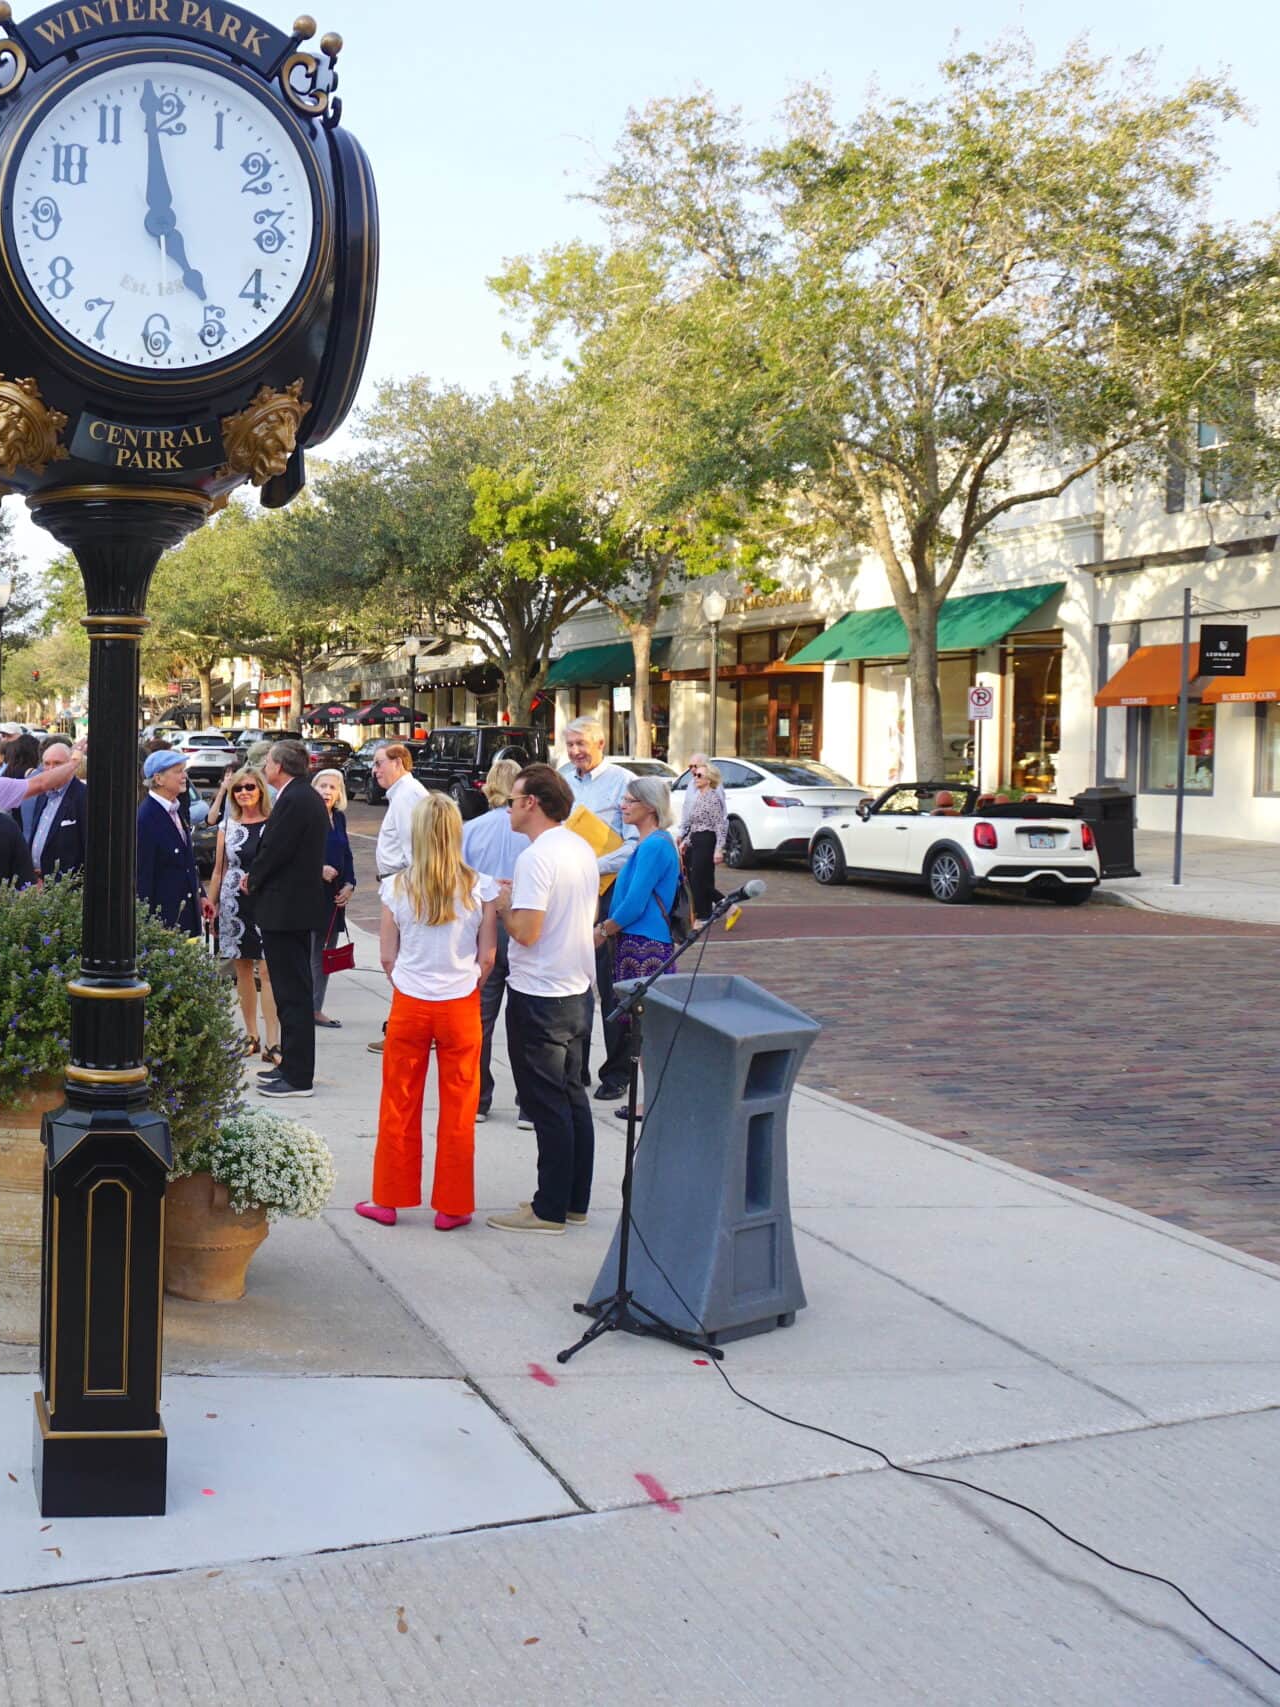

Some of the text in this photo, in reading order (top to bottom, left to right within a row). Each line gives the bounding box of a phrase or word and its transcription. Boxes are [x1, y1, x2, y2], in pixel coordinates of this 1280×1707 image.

[34, 0, 271, 57] WINTER PARK
[97, 104, 122, 145] 11
[144, 92, 187, 136] 2
[214, 111, 224, 151] 1
[52, 143, 88, 186] 10
[240, 152, 272, 195] 2
[30, 196, 62, 241] 9
[253, 209, 287, 254] 3
[47, 255, 74, 299] 8
[238, 268, 269, 309] 4
[84, 297, 114, 341] 7
[141, 313, 172, 358] 6
[198, 304, 228, 348] 5
[89, 421, 212, 449] CENTRAL
[115, 448, 184, 469] PARK
